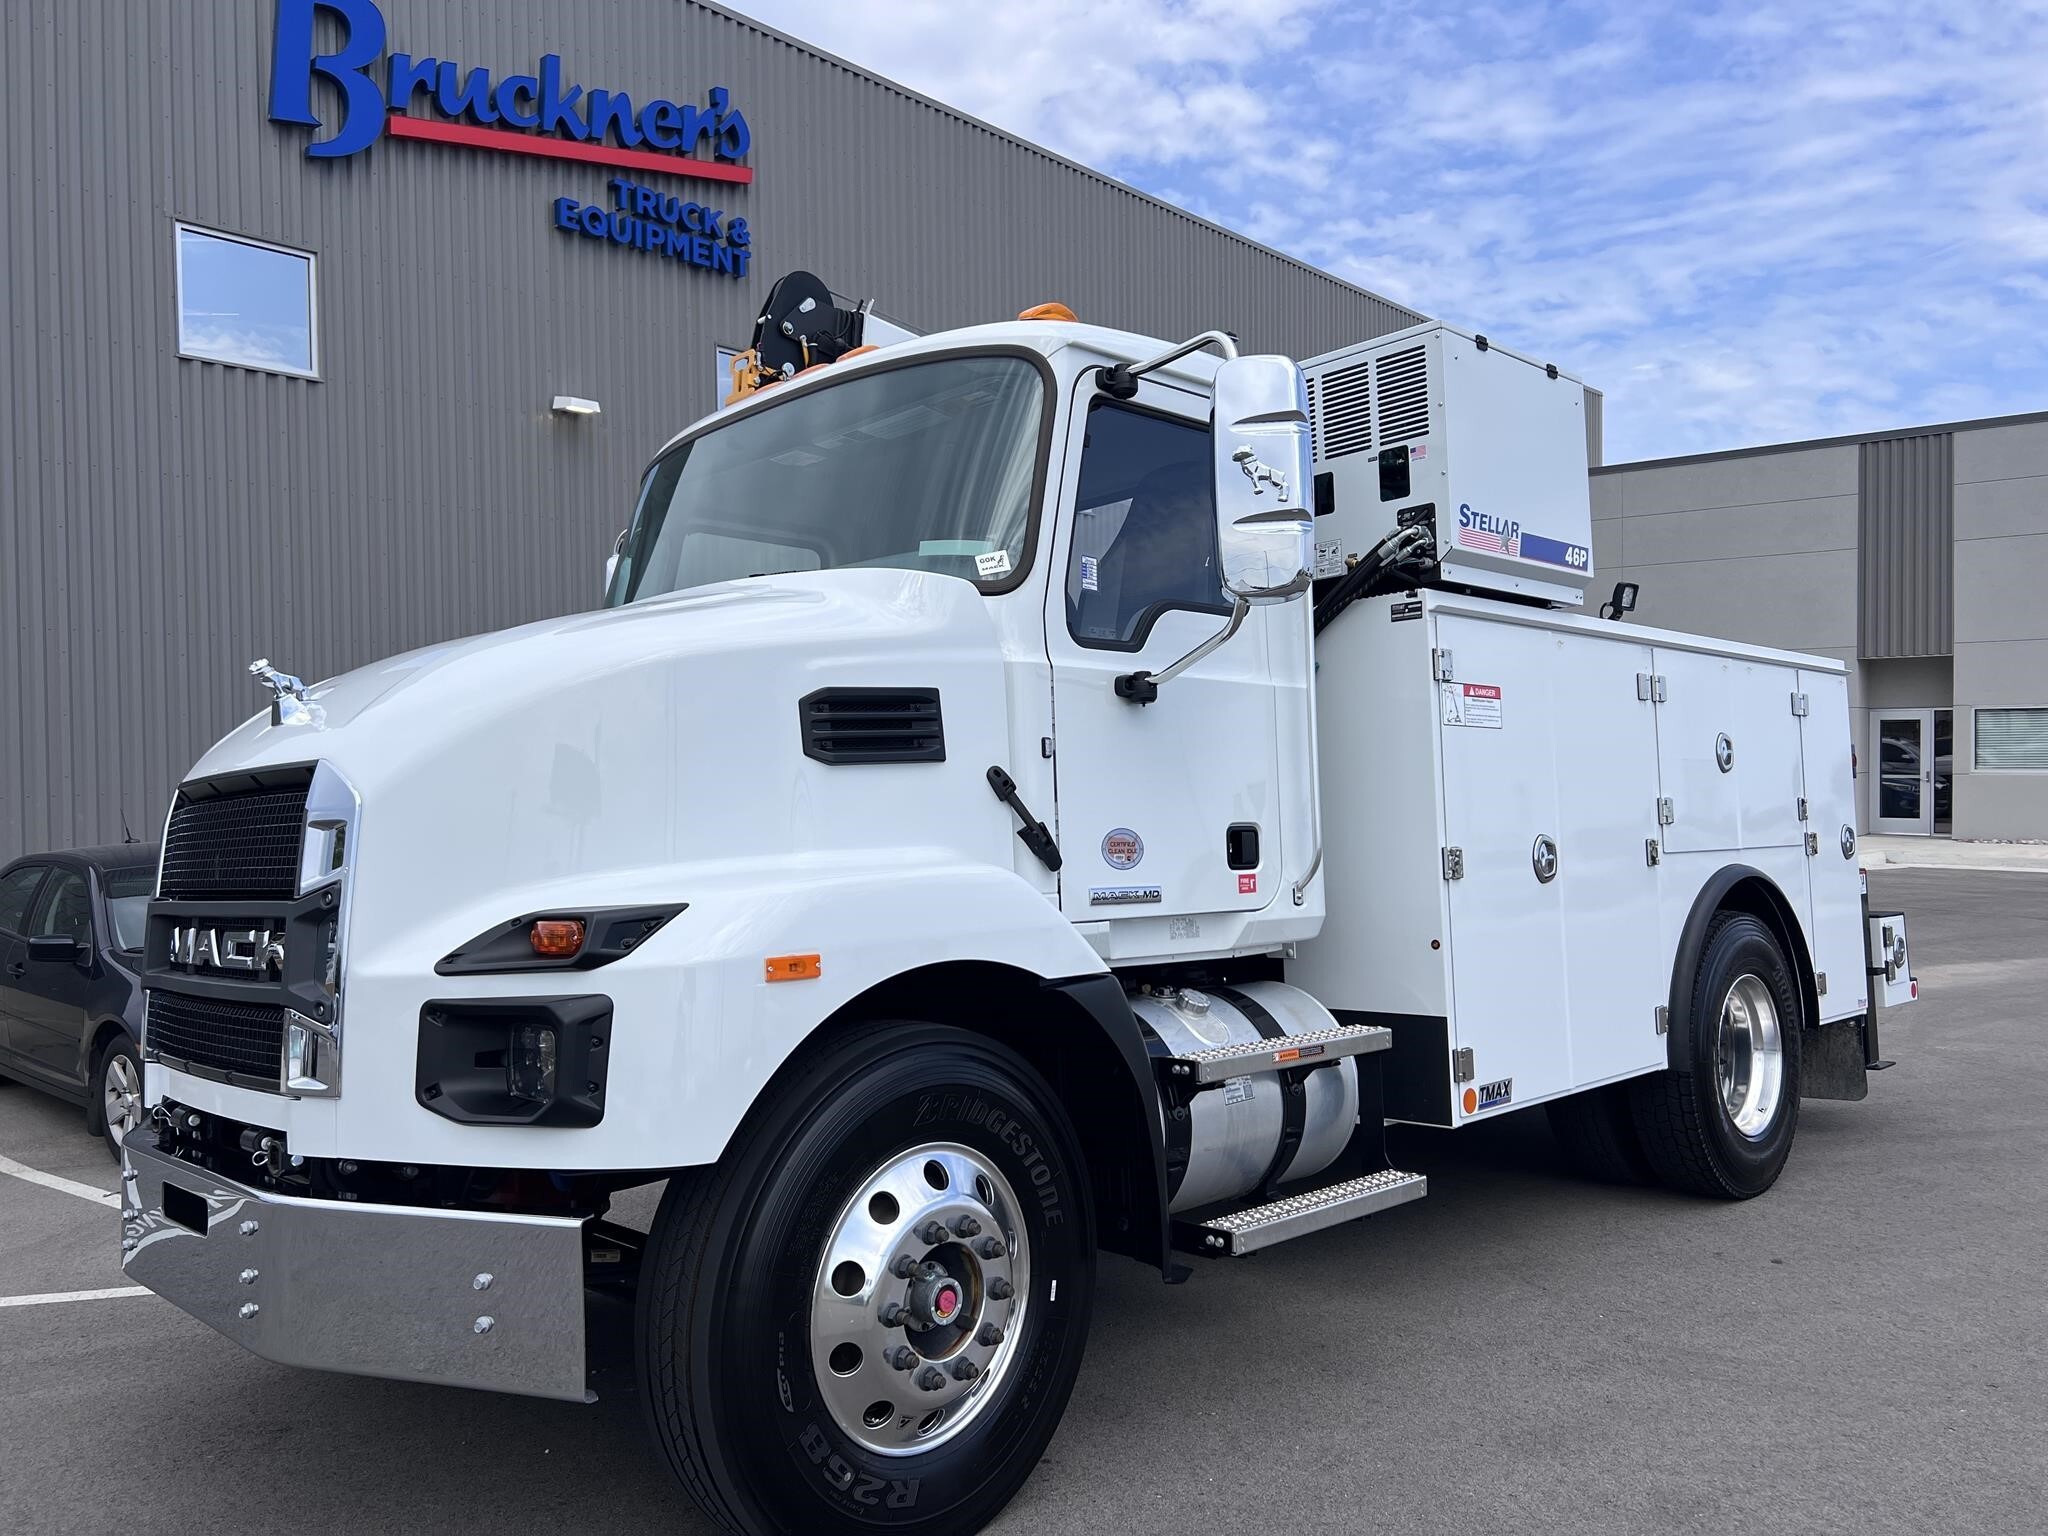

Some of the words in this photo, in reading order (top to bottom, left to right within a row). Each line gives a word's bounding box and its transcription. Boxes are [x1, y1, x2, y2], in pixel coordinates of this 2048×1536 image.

[268, 0, 752, 159] Bruckner's
[607, 176, 724, 239] TRUCK
[727, 217, 752, 247] &
[553, 196, 752, 279] EQUIPMENT
[1459, 503, 1520, 540] STELLAR
[1564, 546, 1588, 568] 46P
[1474, 687, 1496, 697] DANGER
[1091, 890, 1140, 901] MACK
[1142, 889, 1160, 899] MD
[170, 926, 285, 971] MACK
[1479, 1080, 1510, 1103] TMAX
[912, 1094, 1065, 1228] BRIDGESTONE
[800, 1421, 920, 1510] R268
